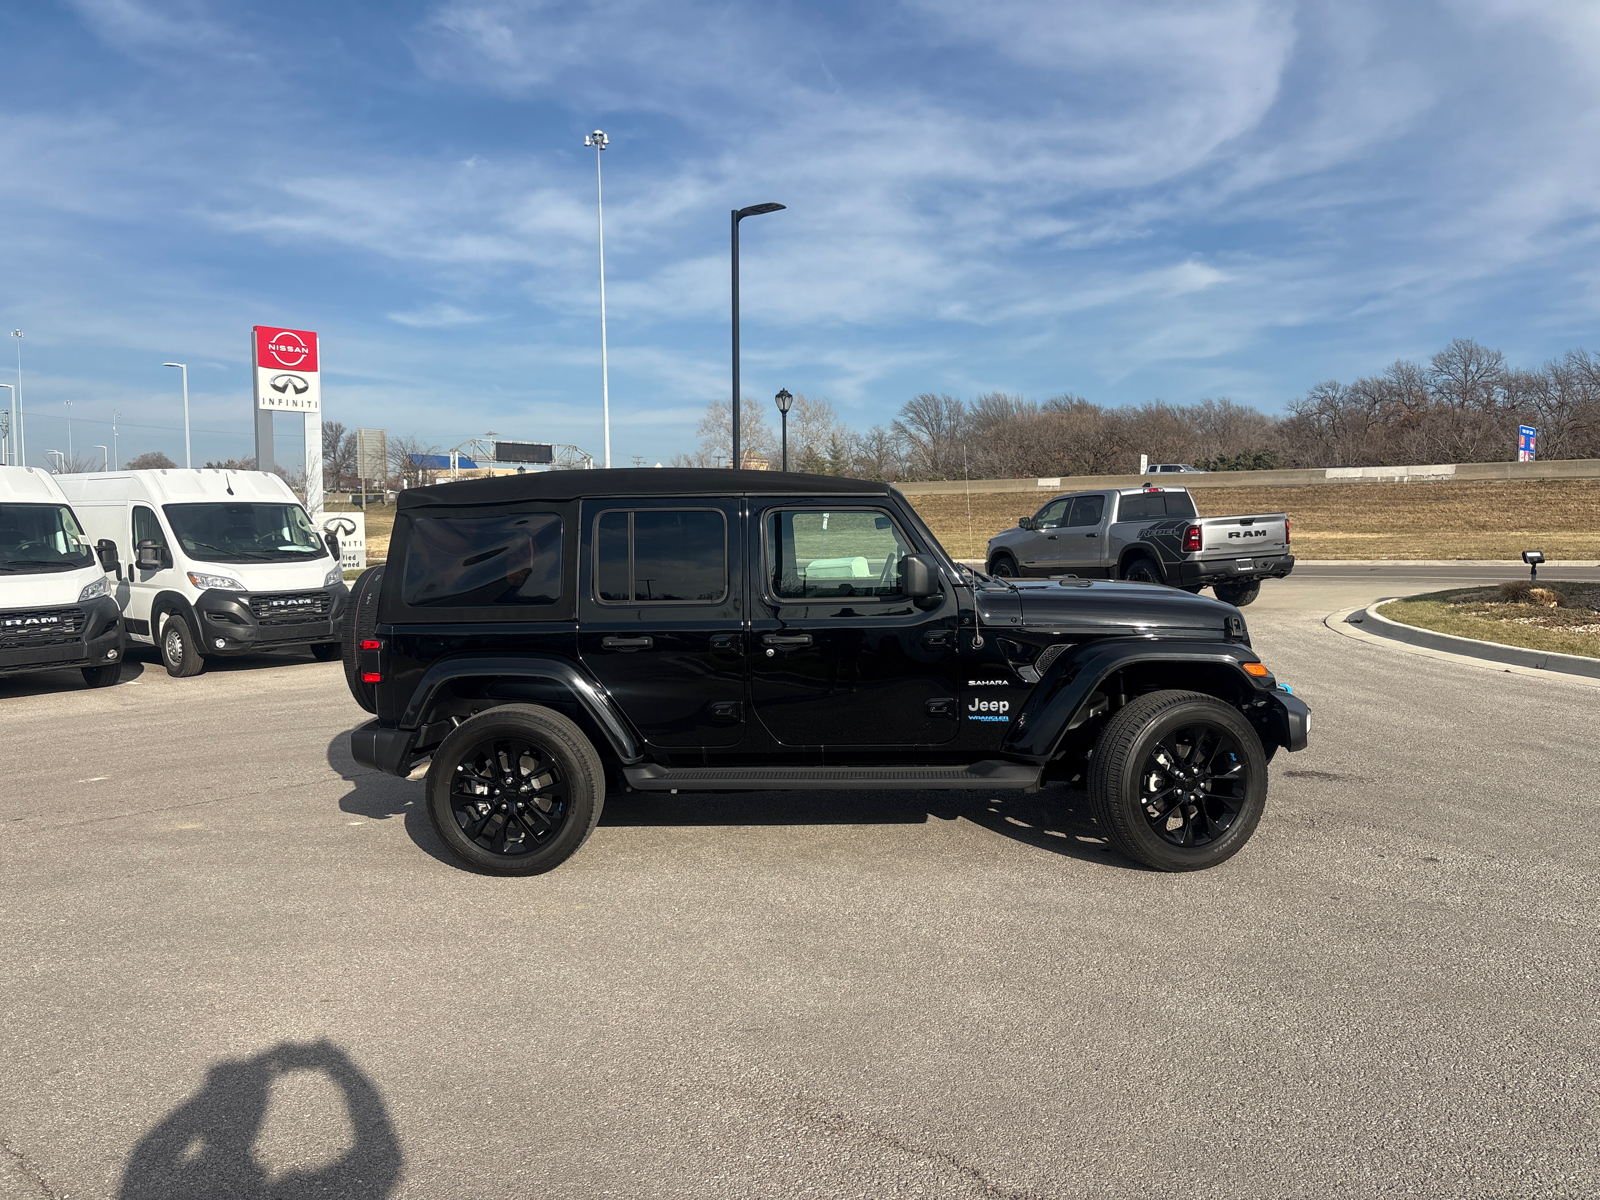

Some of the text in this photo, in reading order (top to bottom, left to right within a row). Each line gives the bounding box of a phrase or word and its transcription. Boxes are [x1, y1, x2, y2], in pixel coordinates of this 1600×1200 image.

[268, 343, 309, 354] NISSAN
[262, 397, 318, 409] INFINITI
[1228, 529, 1267, 539] RAM
[5, 616, 58, 626] RAM
[968, 698, 1009, 714] Jeep
[1213, 832, 1238, 853] ALENZA
